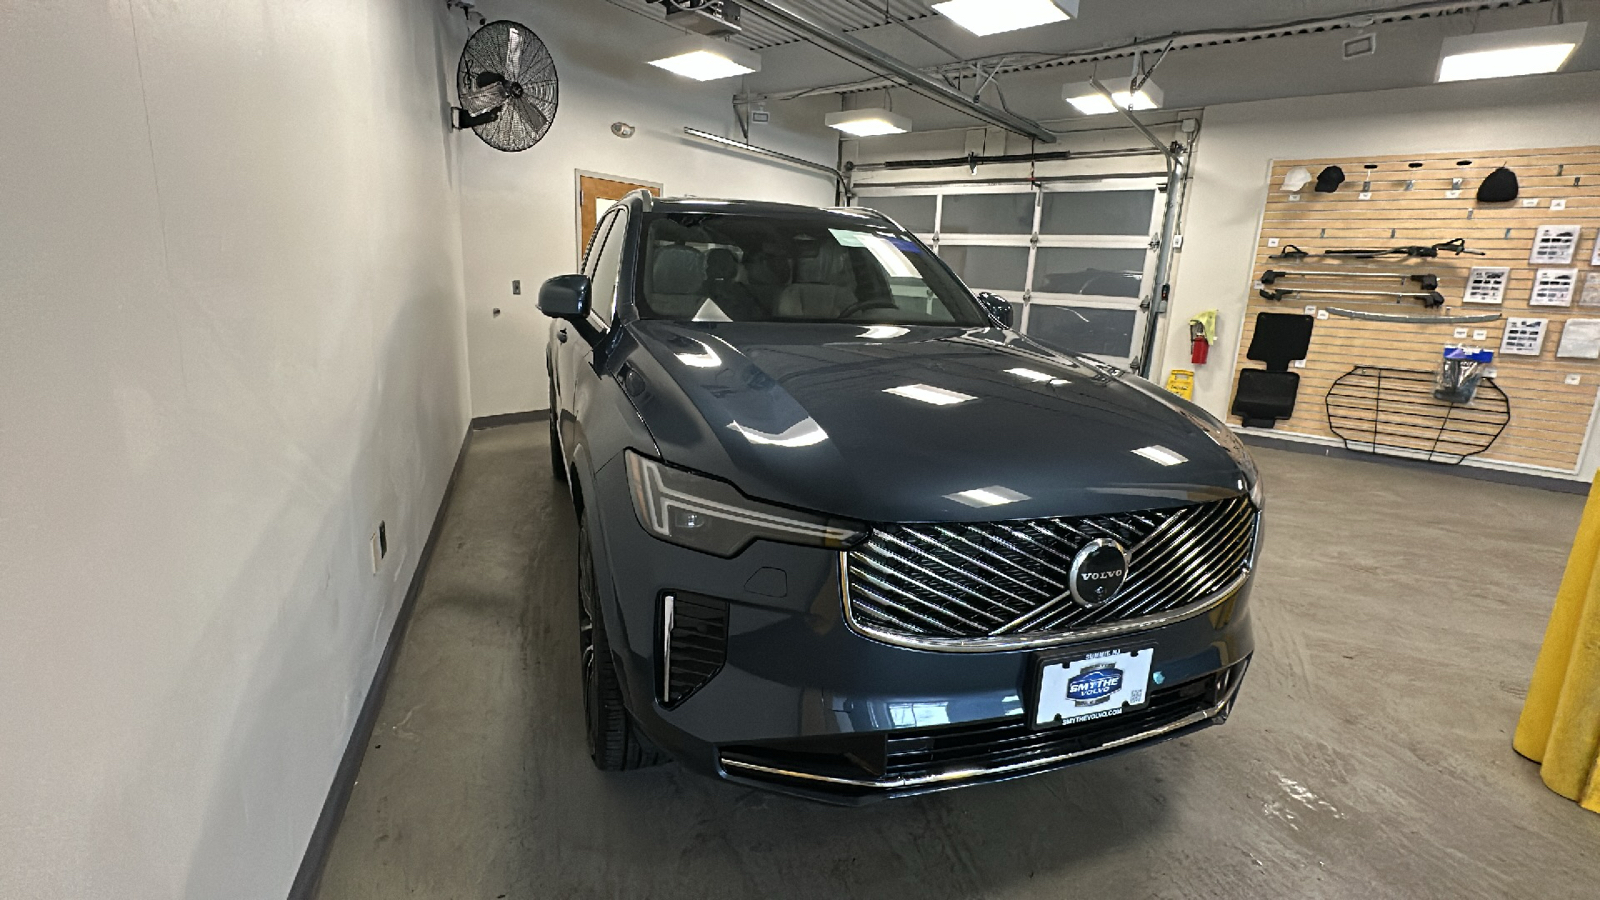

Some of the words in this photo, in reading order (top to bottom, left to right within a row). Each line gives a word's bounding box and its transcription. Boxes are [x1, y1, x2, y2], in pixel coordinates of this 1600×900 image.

[1081, 570, 1122, 580] VOLVO
[1069, 678, 1118, 693] SMYTHE
[1081, 687, 1110, 697] VOLVO
[1062, 708, 1122, 726] SMYTHEVOLVO.COM
